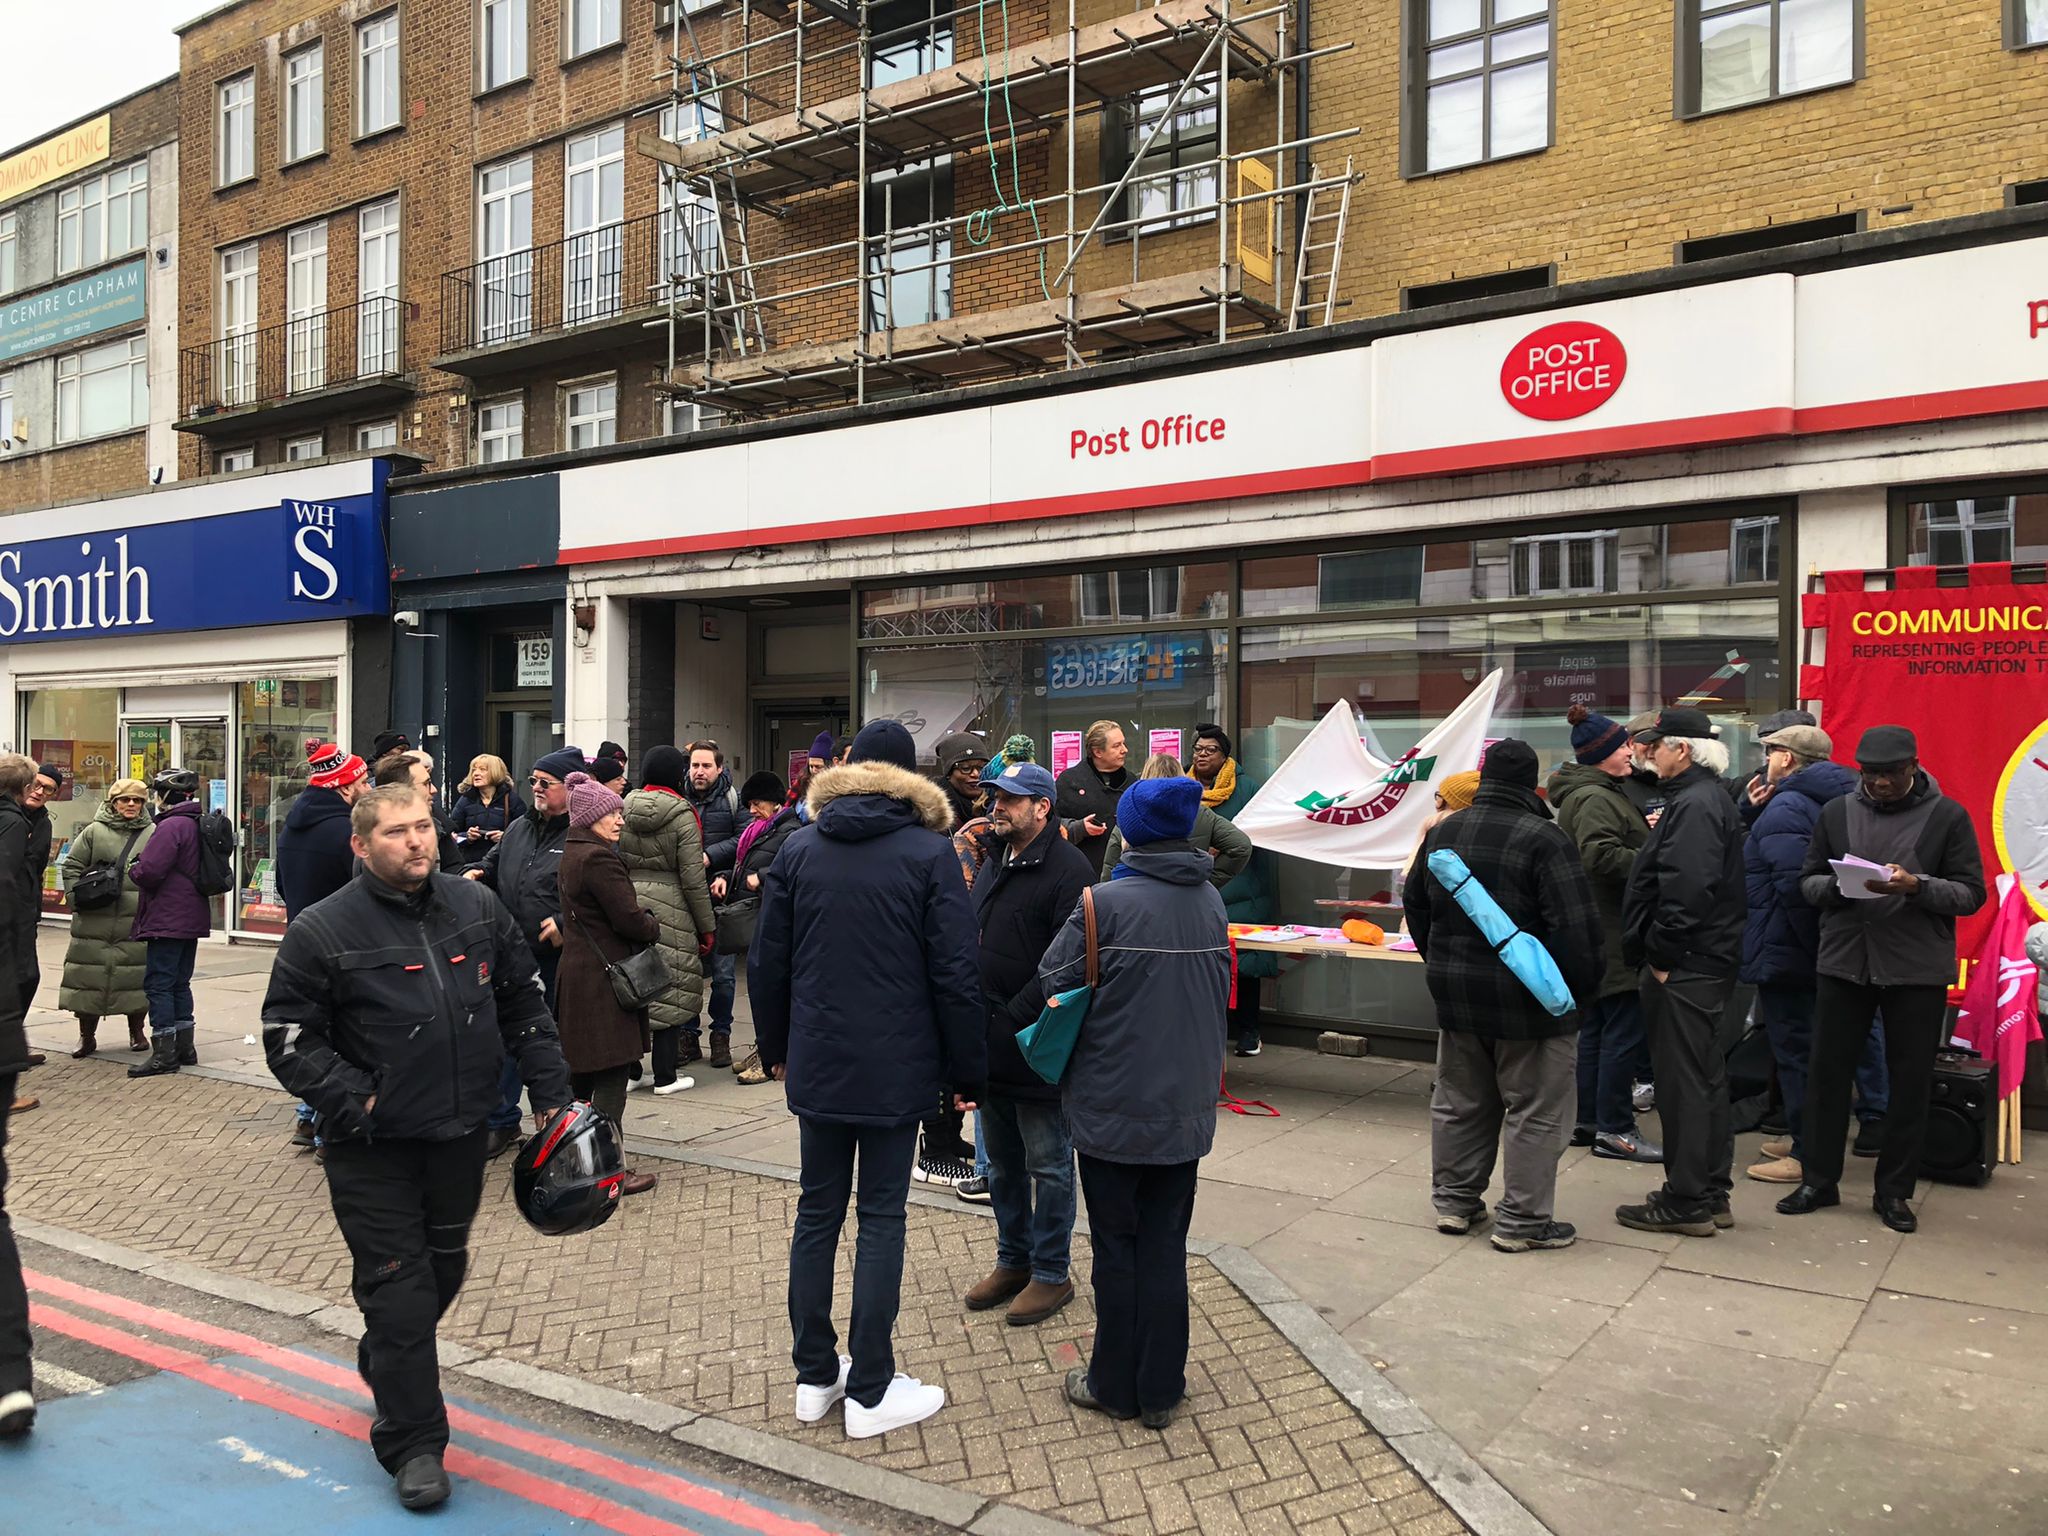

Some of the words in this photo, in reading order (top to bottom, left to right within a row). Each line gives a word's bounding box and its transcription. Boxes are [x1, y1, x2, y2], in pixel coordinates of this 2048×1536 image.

[56, 126, 104, 168] CLINIC
[10, 295, 60, 325] CENTRE
[67, 270, 138, 306] CLAPHAM
[1528, 338, 1601, 371] POST
[1511, 364, 1611, 400] OFFICE
[1070, 426, 1130, 459] Post
[1141, 414, 1226, 450] Office
[292, 501, 336, 528] WH
[0, 533, 154, 637] Smith
[1852, 605, 2048, 635] COMMUNIC
[521, 642, 551, 661] 159
[1852, 641, 1976, 658] REPRESENTING
[1983, 640, 2048, 656] PEOPLE
[1908, 658, 2027, 675] INFORMATION
